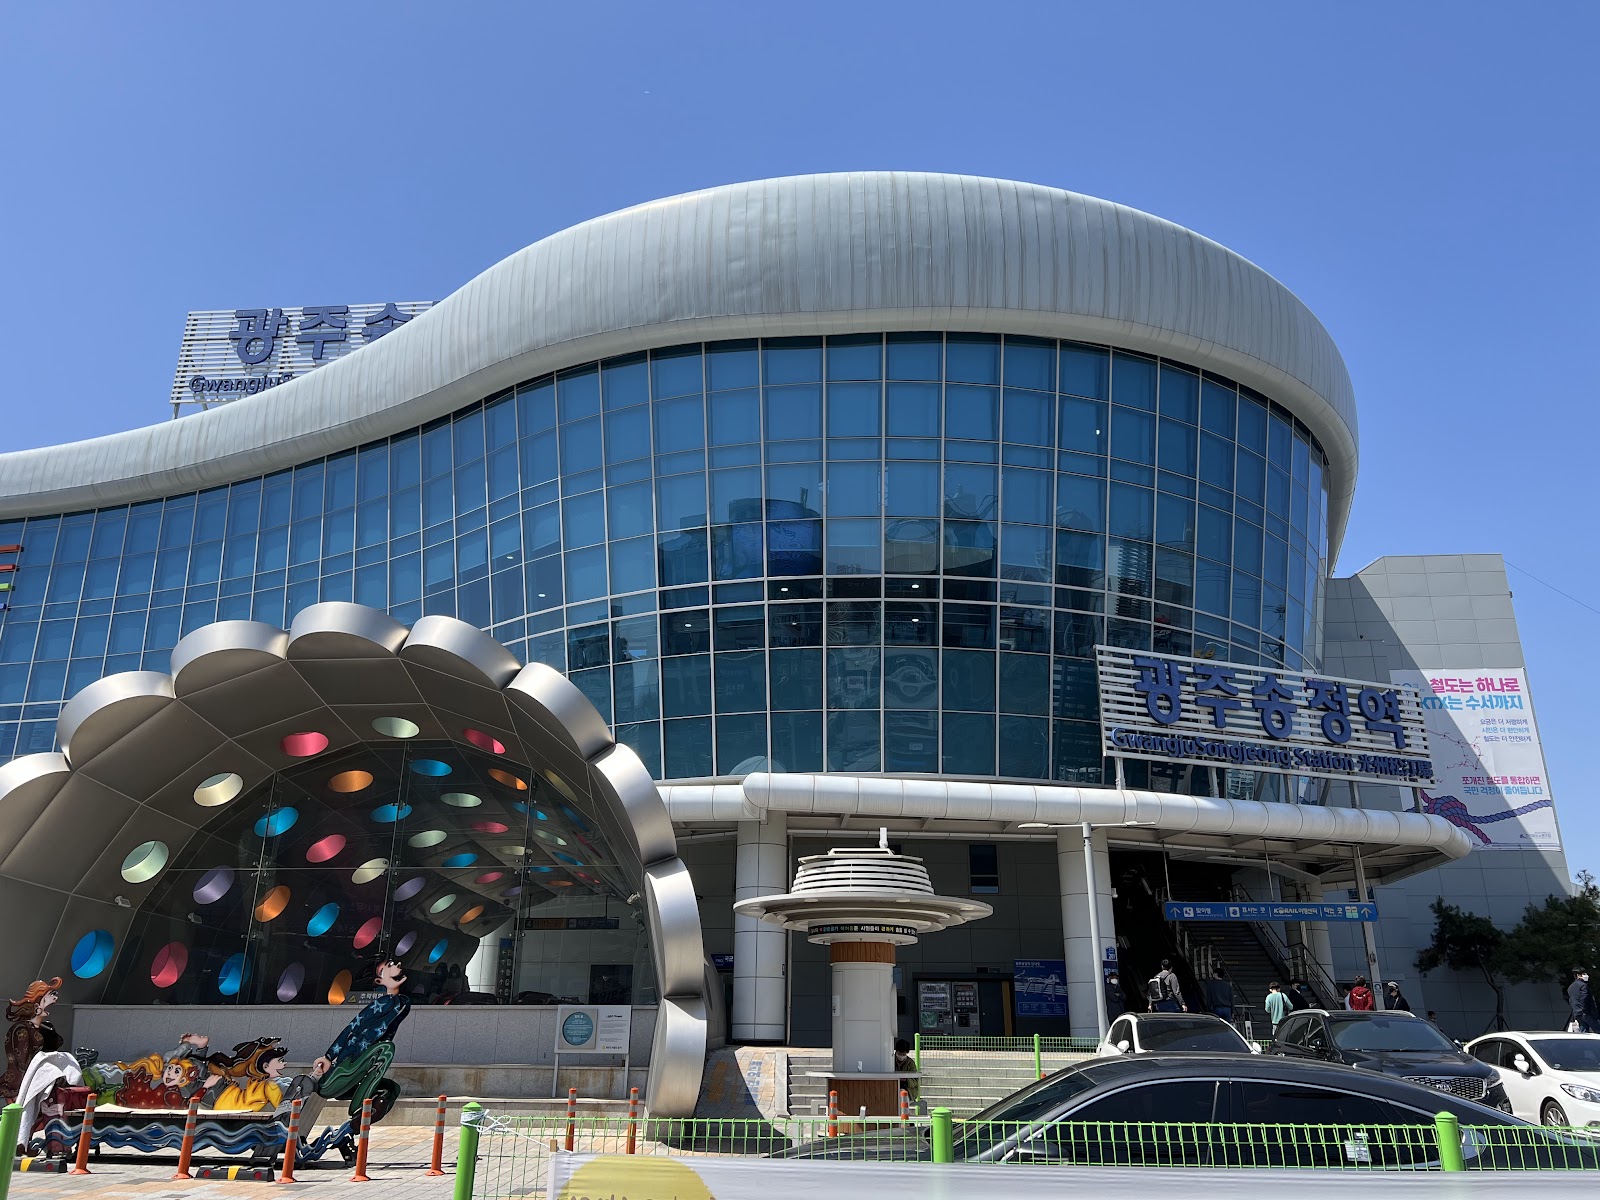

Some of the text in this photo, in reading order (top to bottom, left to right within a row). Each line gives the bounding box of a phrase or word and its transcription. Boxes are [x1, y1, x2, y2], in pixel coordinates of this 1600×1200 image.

[1429, 678, 1474, 693] 철도는
[1475, 677, 1521, 693] 하나로
[1133, 656, 1407, 750] 광주송정역
[1421, 695, 1524, 710] KTX는 수서까지
[1294, 747, 1354, 772] Station
[1462, 776, 1485, 785] 쪼개진
[1464, 786, 1479, 795] 국민
[1480, 786, 1502, 795] 걱정이
